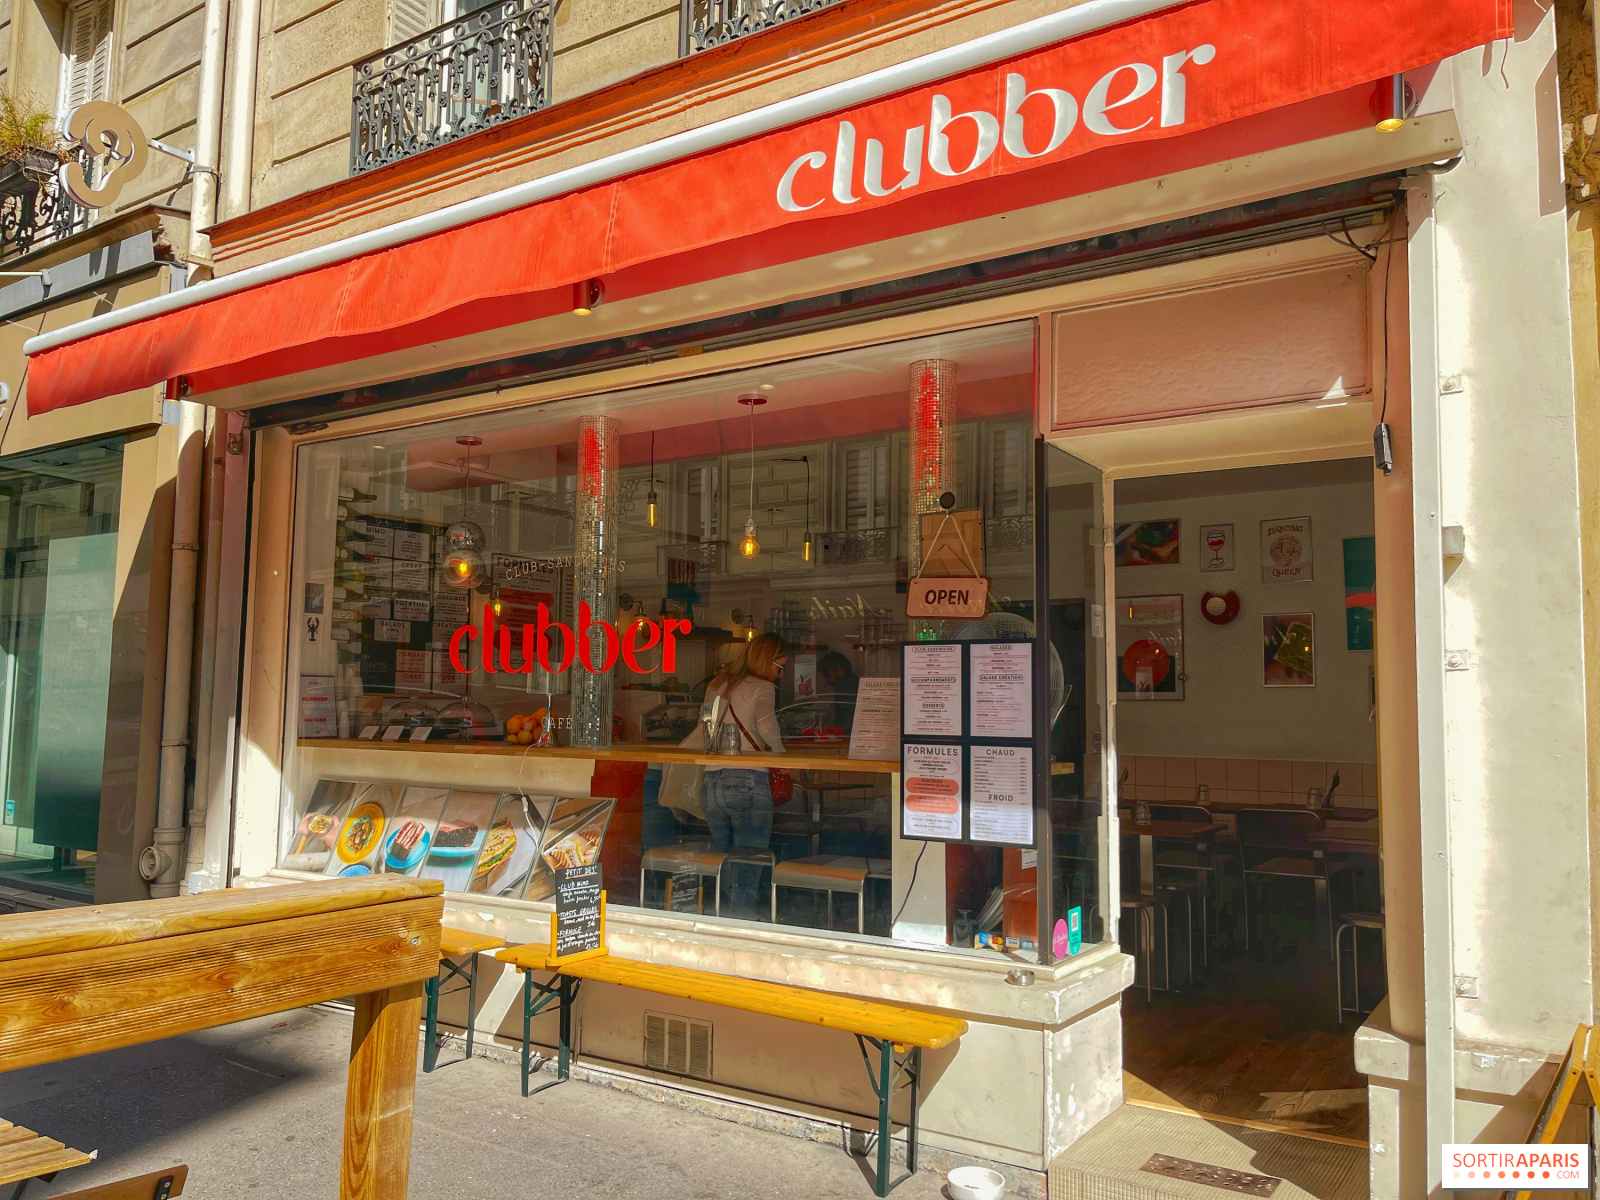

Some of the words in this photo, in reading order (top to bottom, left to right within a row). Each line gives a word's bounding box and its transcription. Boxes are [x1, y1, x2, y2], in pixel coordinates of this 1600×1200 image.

[776, 43, 1217, 212] clubber
[1267, 524, 1304, 536] DANCING
[1272, 567, 1302, 578] QUEEN
[924, 589, 970, 605] OPEN
[448, 600, 693, 674] clubber
[907, 746, 958, 757] FORMULES
[985, 748, 1015, 756] CHAUD
[988, 794, 1014, 802] FROID
